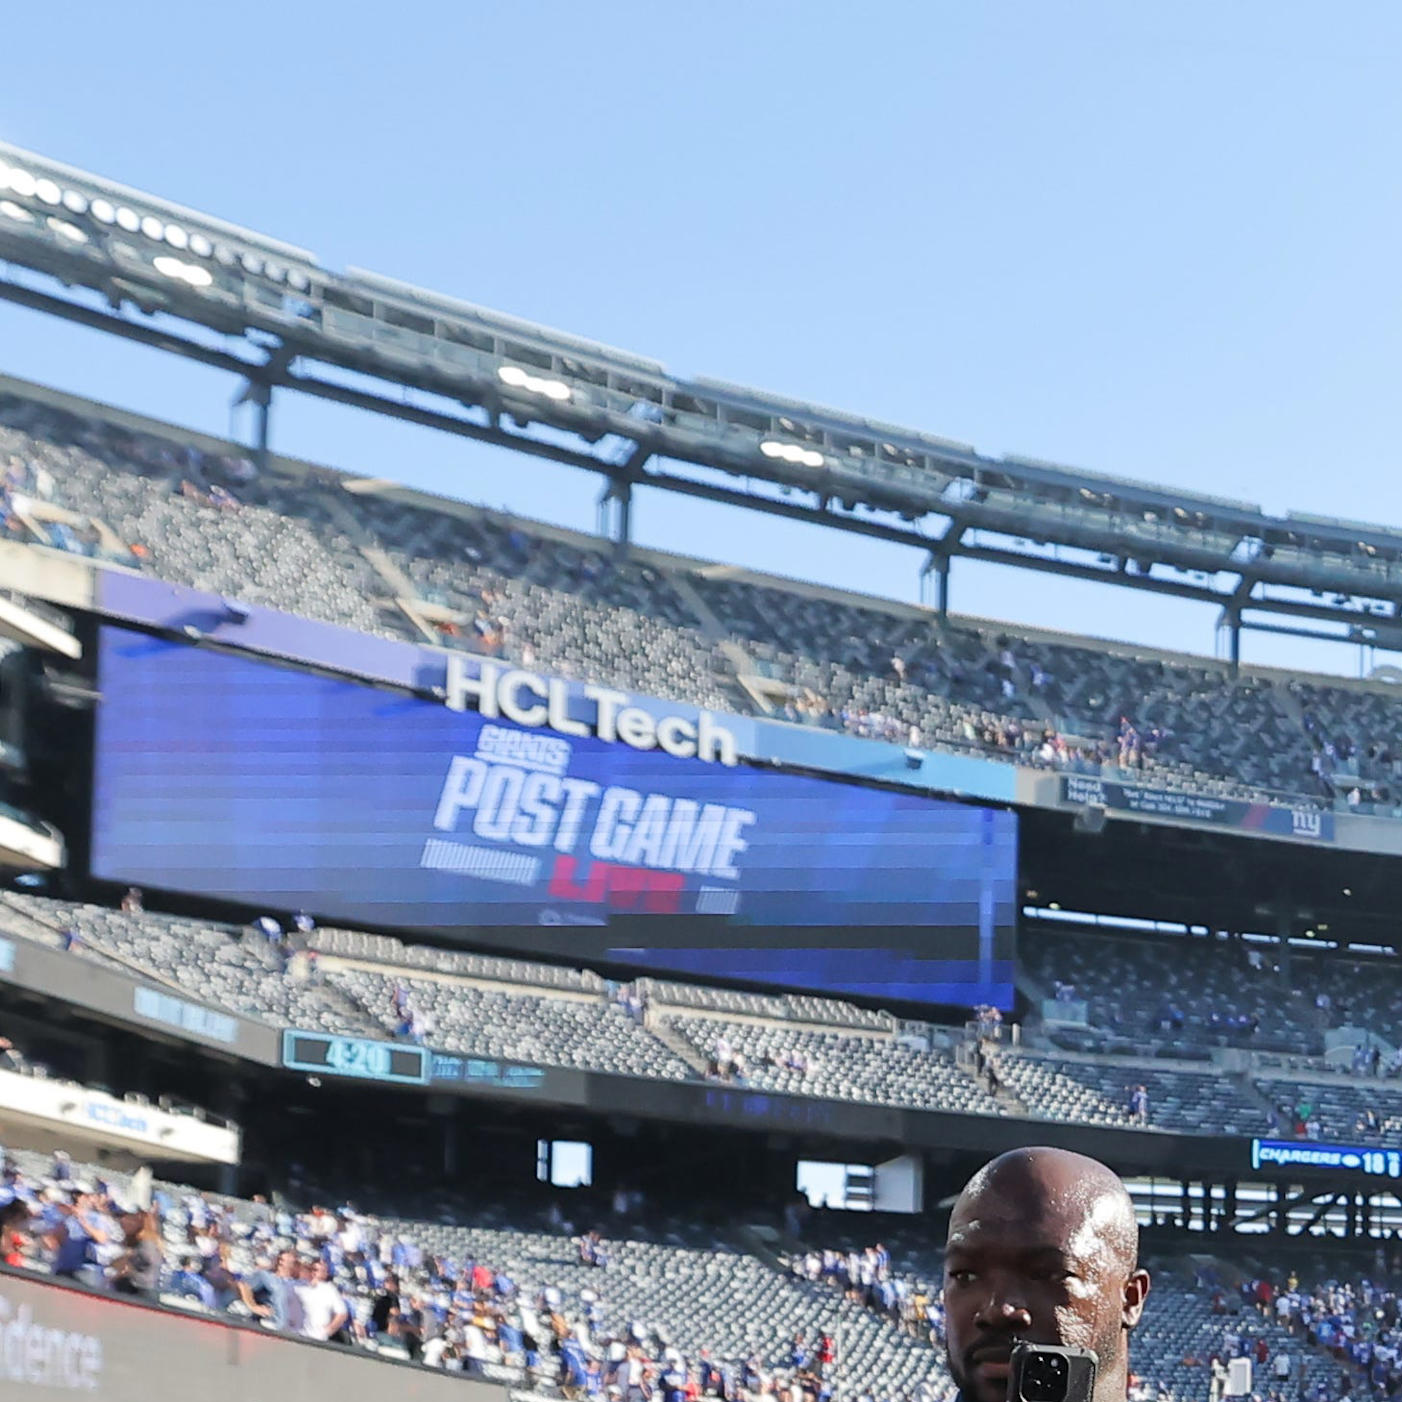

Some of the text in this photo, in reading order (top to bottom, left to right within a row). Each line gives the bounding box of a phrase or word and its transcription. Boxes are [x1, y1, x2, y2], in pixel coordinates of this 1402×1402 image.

[445, 655, 738, 767] HCLTech
[475, 724, 571, 767] GIANTS
[433, 755, 757, 880] POST GAME
[1259, 1148, 1341, 1166] CHARGERS
[0, 1296, 104, 1391] dence
